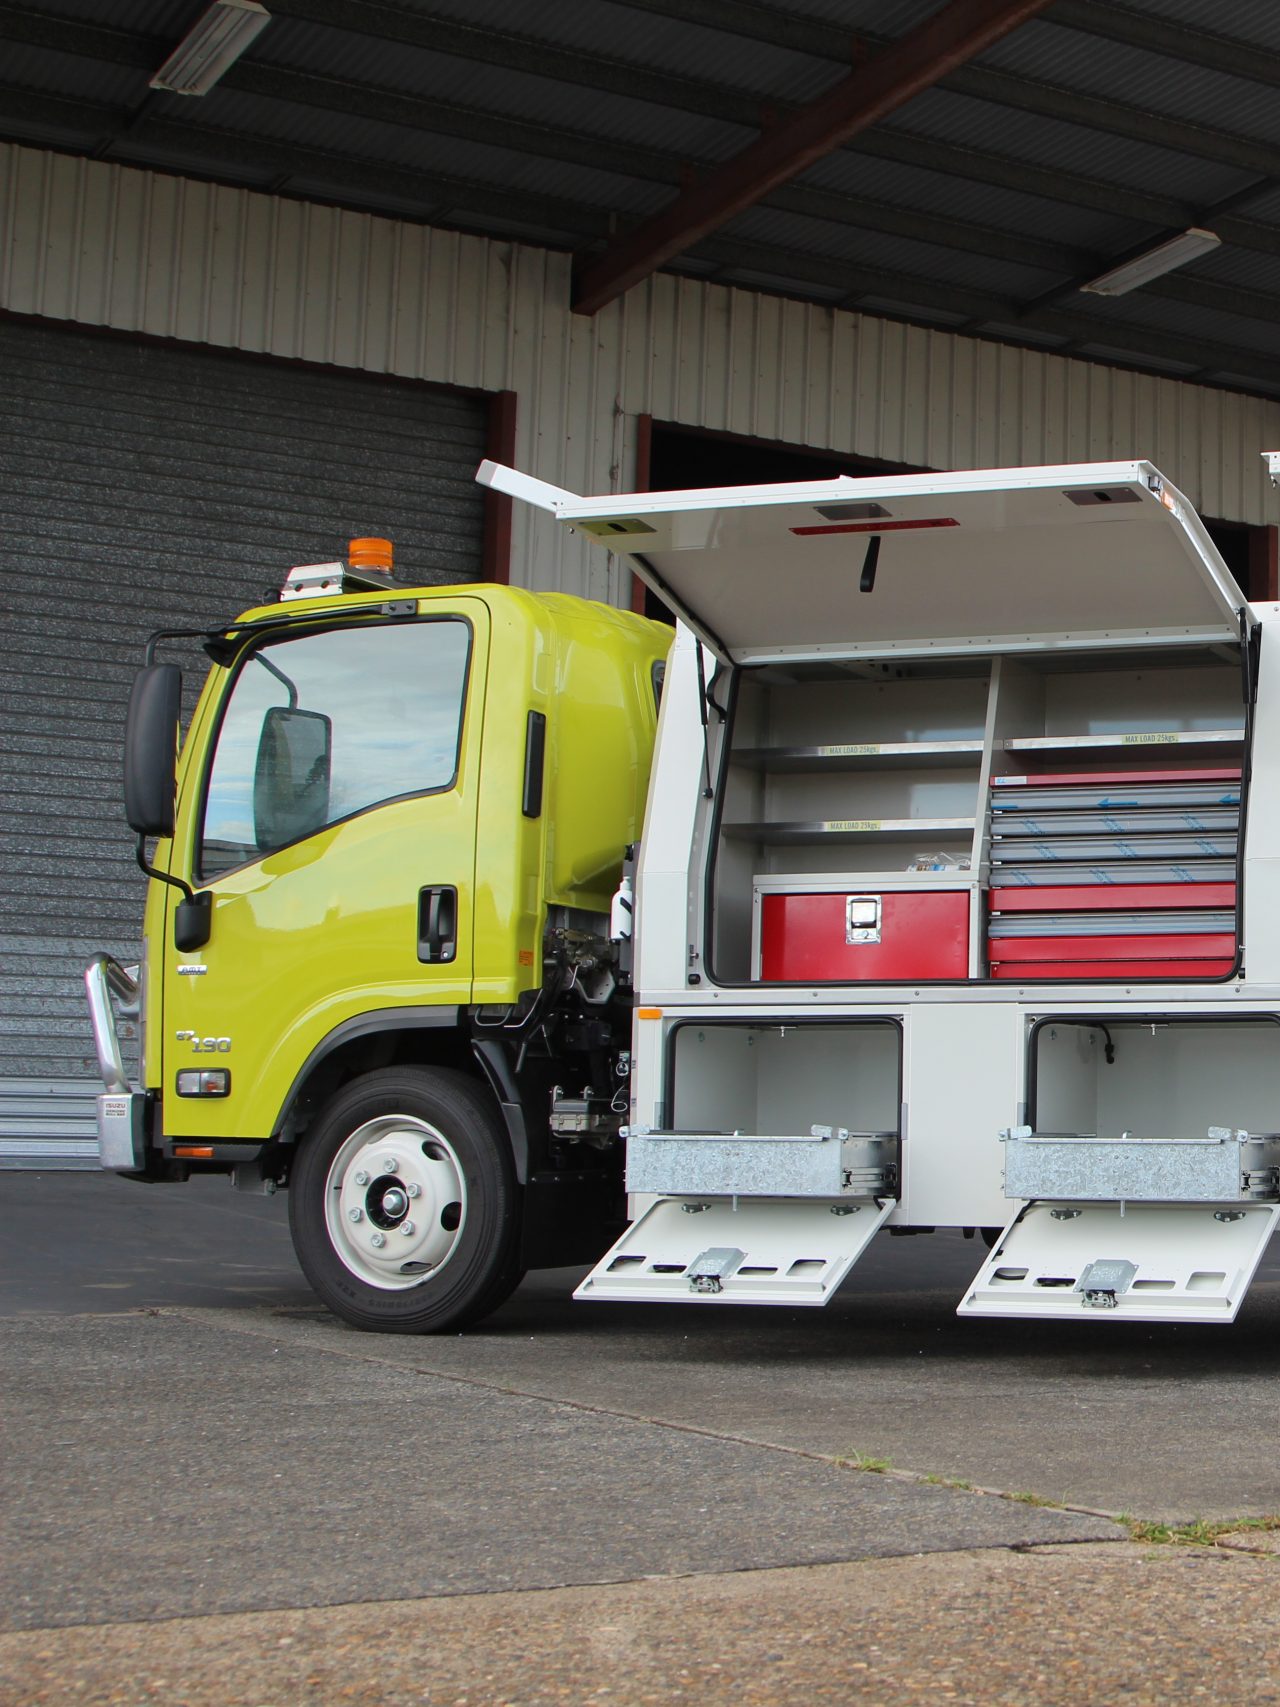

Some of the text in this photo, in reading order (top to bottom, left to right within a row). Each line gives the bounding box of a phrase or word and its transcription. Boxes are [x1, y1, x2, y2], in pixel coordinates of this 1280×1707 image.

[1125, 735, 1138, 743] MAX
[1140, 734, 1156, 743] LOAD
[829, 746, 842, 754] MAX
[843, 746, 857, 754] LOAD
[830, 822, 843, 830] MAX
[844, 822, 859, 830] LOAD
[191, 1036, 232, 1053] 190
